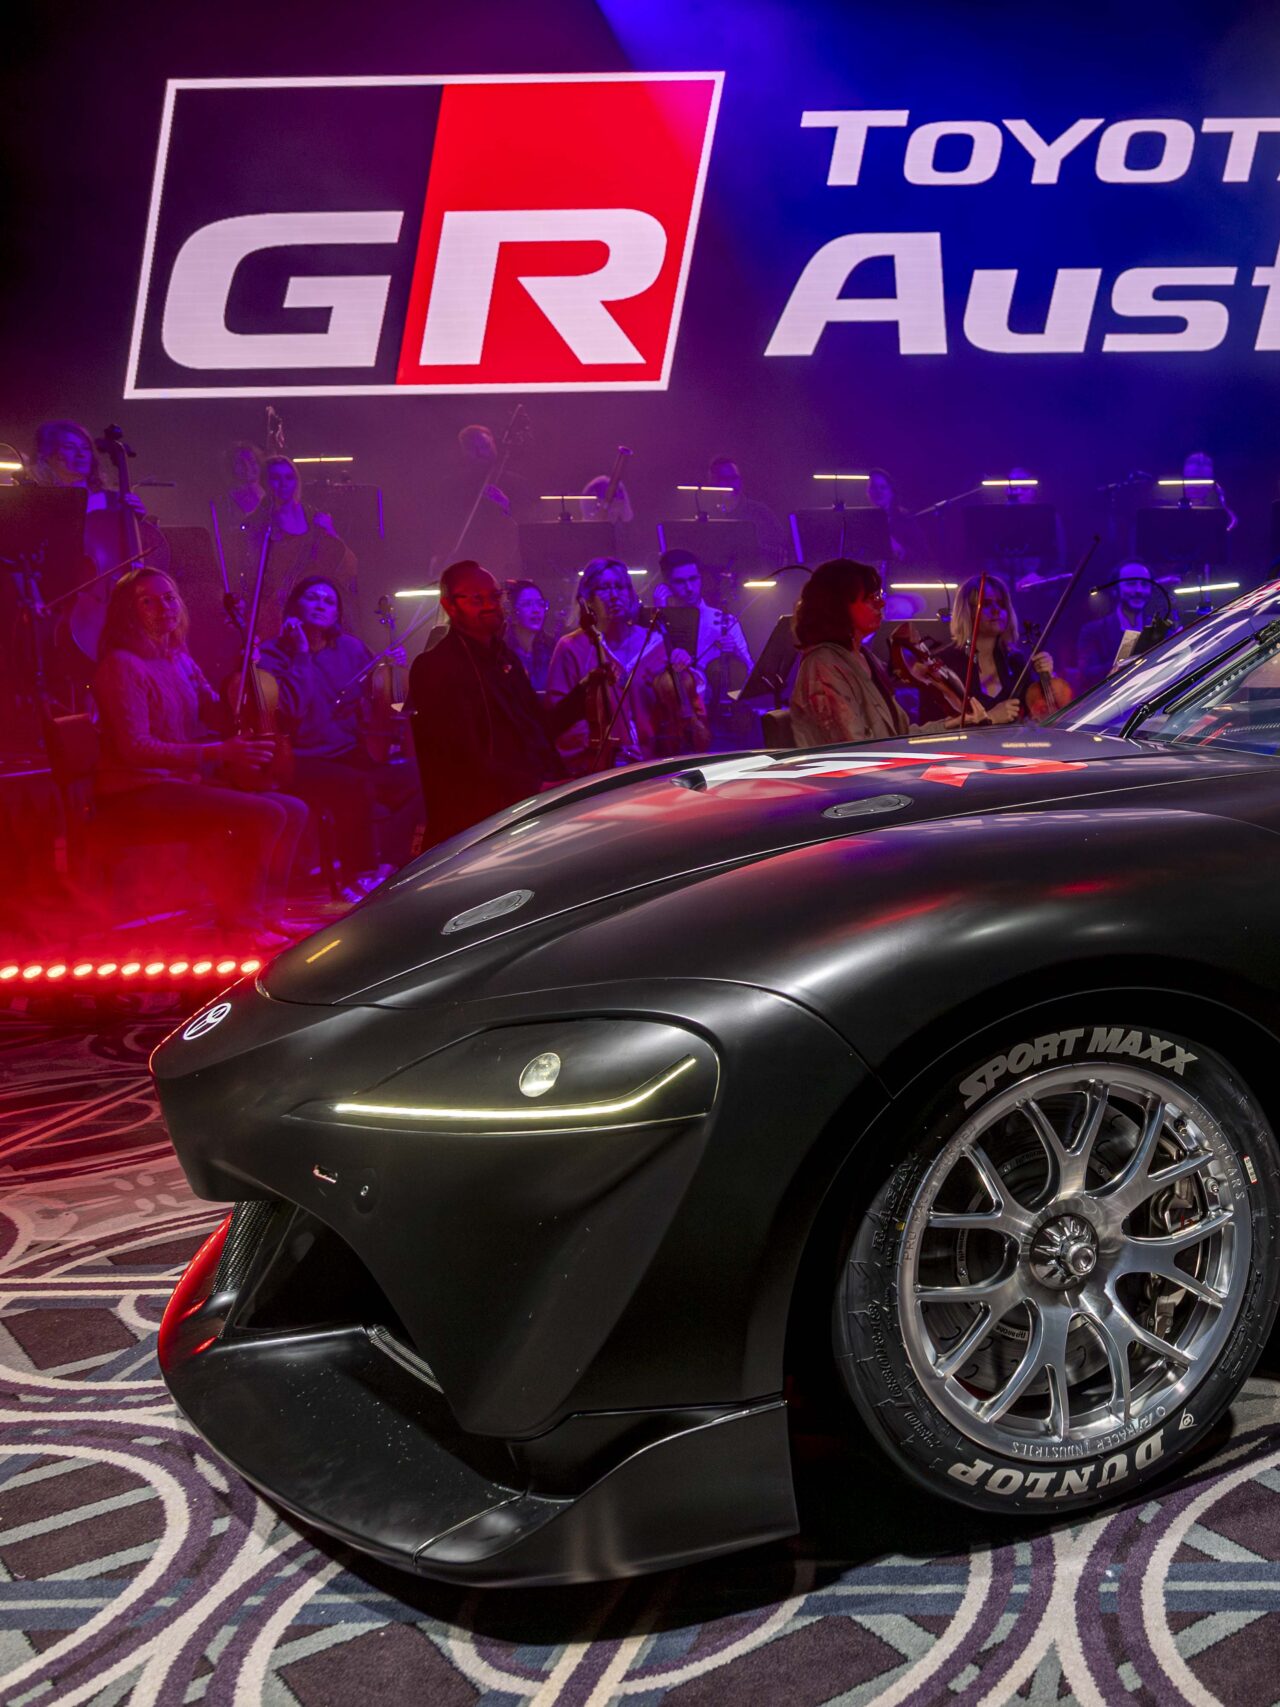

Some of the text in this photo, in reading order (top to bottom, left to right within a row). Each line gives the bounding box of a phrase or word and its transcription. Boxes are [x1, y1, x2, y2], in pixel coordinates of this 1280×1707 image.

[161, 207, 668, 370] GR
[957, 1026, 1199, 1111] SPORT MAXX
[947, 1430, 1167, 1500] DUNLOP
